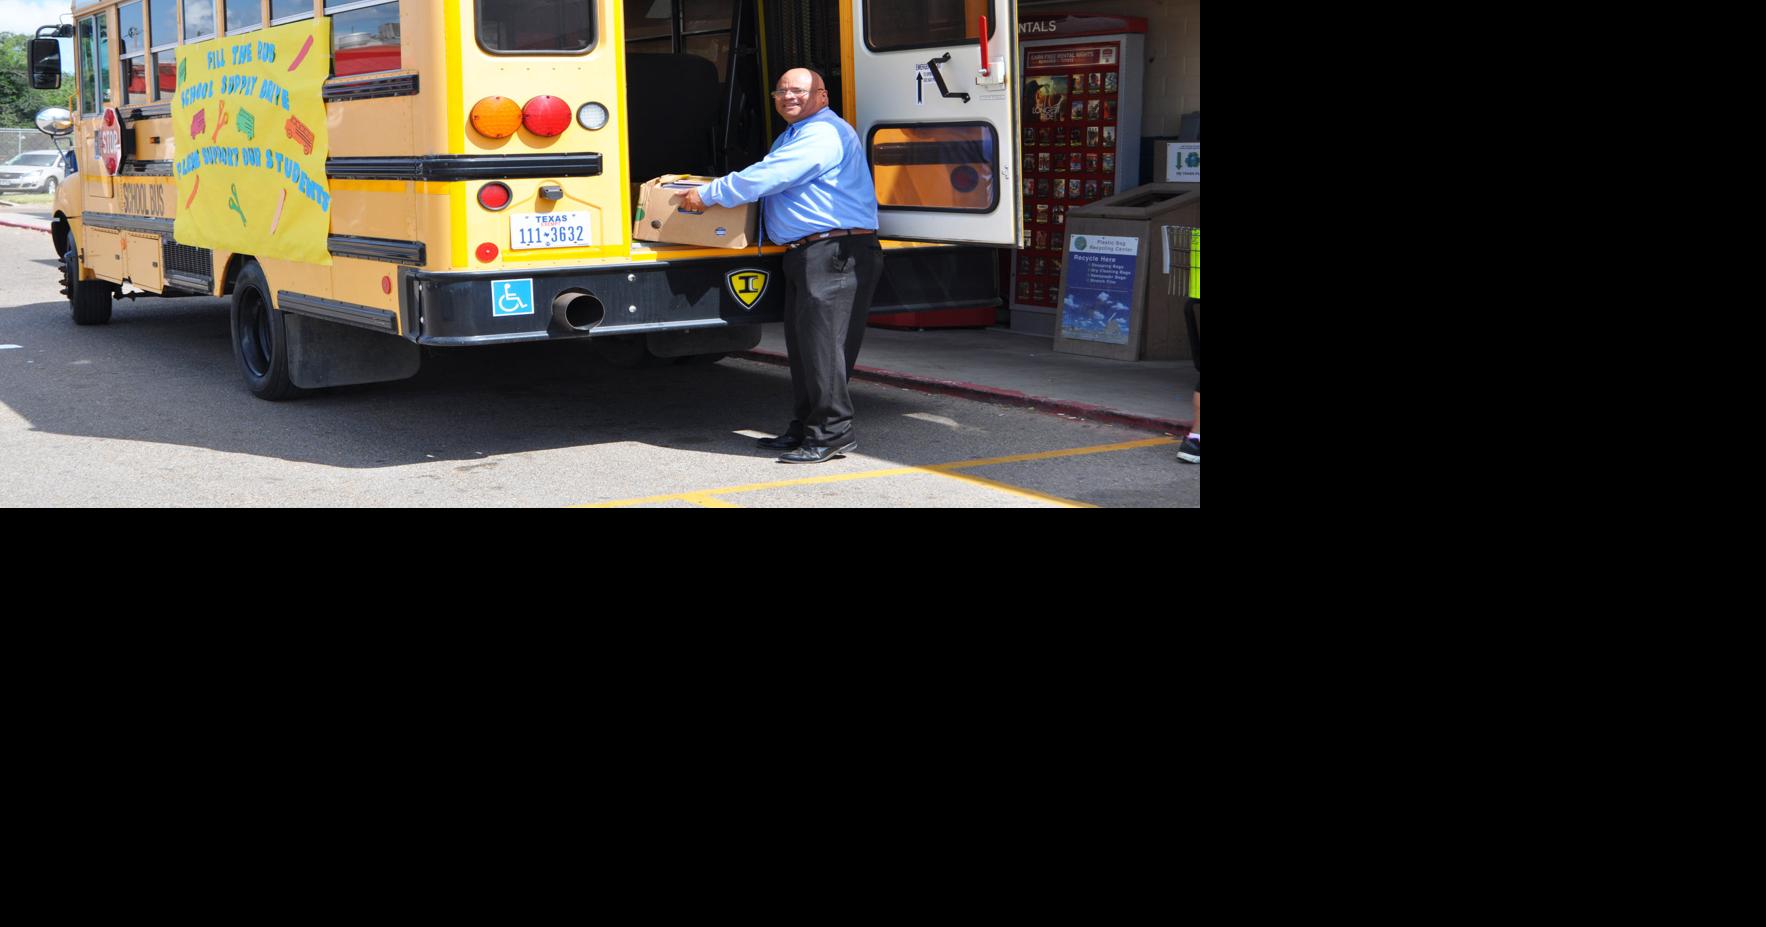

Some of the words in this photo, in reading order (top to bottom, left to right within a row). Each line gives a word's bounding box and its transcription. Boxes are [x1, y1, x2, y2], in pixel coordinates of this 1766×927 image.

[208, 49, 225, 70] FILL
[232, 44, 252, 65] THE
[257, 40, 276, 63] BUS
[181, 79, 213, 109] SCHOOL
[221, 74, 257, 96] SUPPLY
[259, 79, 290, 112] DRIVE
[102, 130, 118, 154] STOP
[242, 148, 261, 167] OUR
[265, 149, 331, 213] STUDENTS
[123, 182, 149, 214] SCHOOL
[149, 183, 164, 216] BUS
